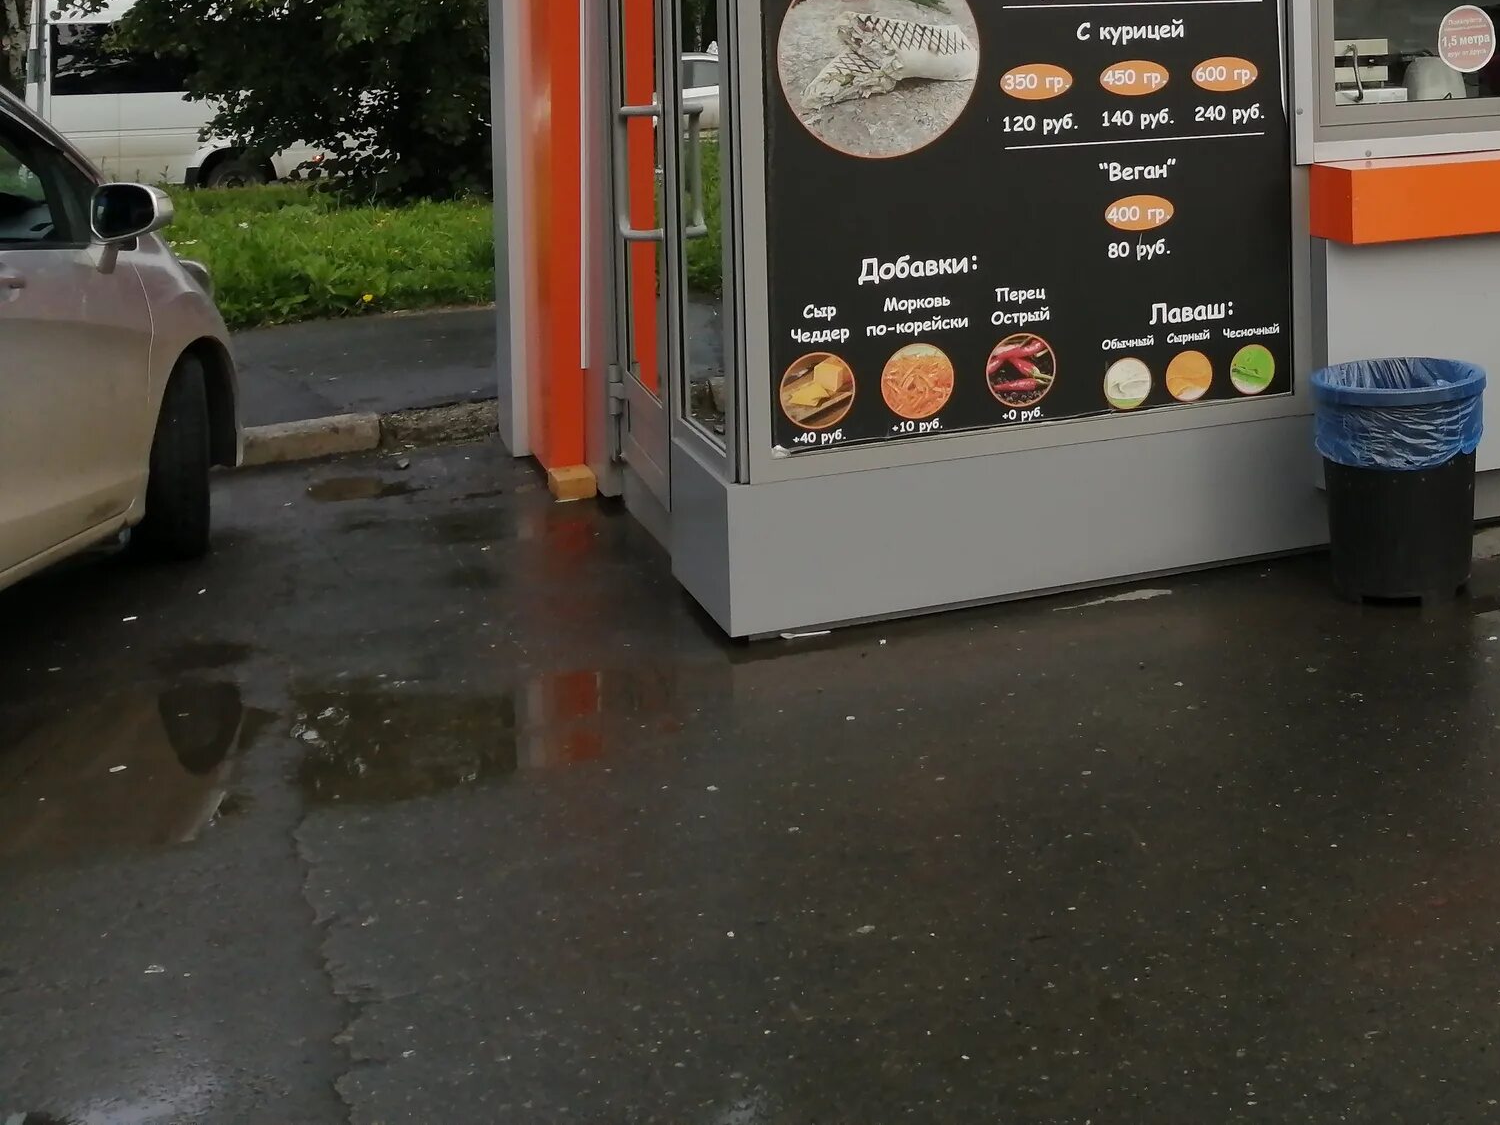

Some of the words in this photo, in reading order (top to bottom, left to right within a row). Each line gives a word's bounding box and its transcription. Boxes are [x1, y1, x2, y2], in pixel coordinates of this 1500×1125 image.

[1076, 22, 1090, 41] С
[1100, 19, 1184, 45] курицей
[1004, 73, 1037, 90] 350
[1045, 75, 1069, 96] гр.
[1103, 70, 1136, 85] 450
[1143, 70, 1167, 91] гр.
[1195, 66, 1227, 82] 600
[1233, 67, 1257, 87] гр.
[1002, 114, 1035, 133] 120
[1043, 113, 1079, 135] руб.
[1101, 110, 1132, 127] 140
[1140, 108, 1174, 131] руб.
[1194, 105, 1226, 122] 240
[1232, 103, 1264, 124] руб.
[1107, 206, 1140, 222] 400
[1147, 206, 1171, 227] гр.
[1107, 241, 1129, 258] 80
[1136, 239, 1171, 260] руб.
[858, 254, 979, 285] Добавки:
[883, 295, 951, 313] Морковь
[995, 287, 1045, 304] Перец
[803, 303, 836, 322] Сыр
[991, 308, 1050, 327] Острый
[1149, 300, 1234, 327] Лаваш:
[790, 327, 849, 344] Чеддер
[866, 316, 969, 337] по-корейски
[1223, 324, 1280, 341] Чесночный
[1101, 334, 1154, 351] Обычный
[1167, 329, 1210, 345] Сырный
[1002, 409, 1018, 420] +0
[1021, 407, 1044, 421] руб.
[892, 420, 916, 432] +10
[919, 418, 943, 433] руб.
[792, 432, 817, 444] +40
[821, 428, 847, 445] руб.
